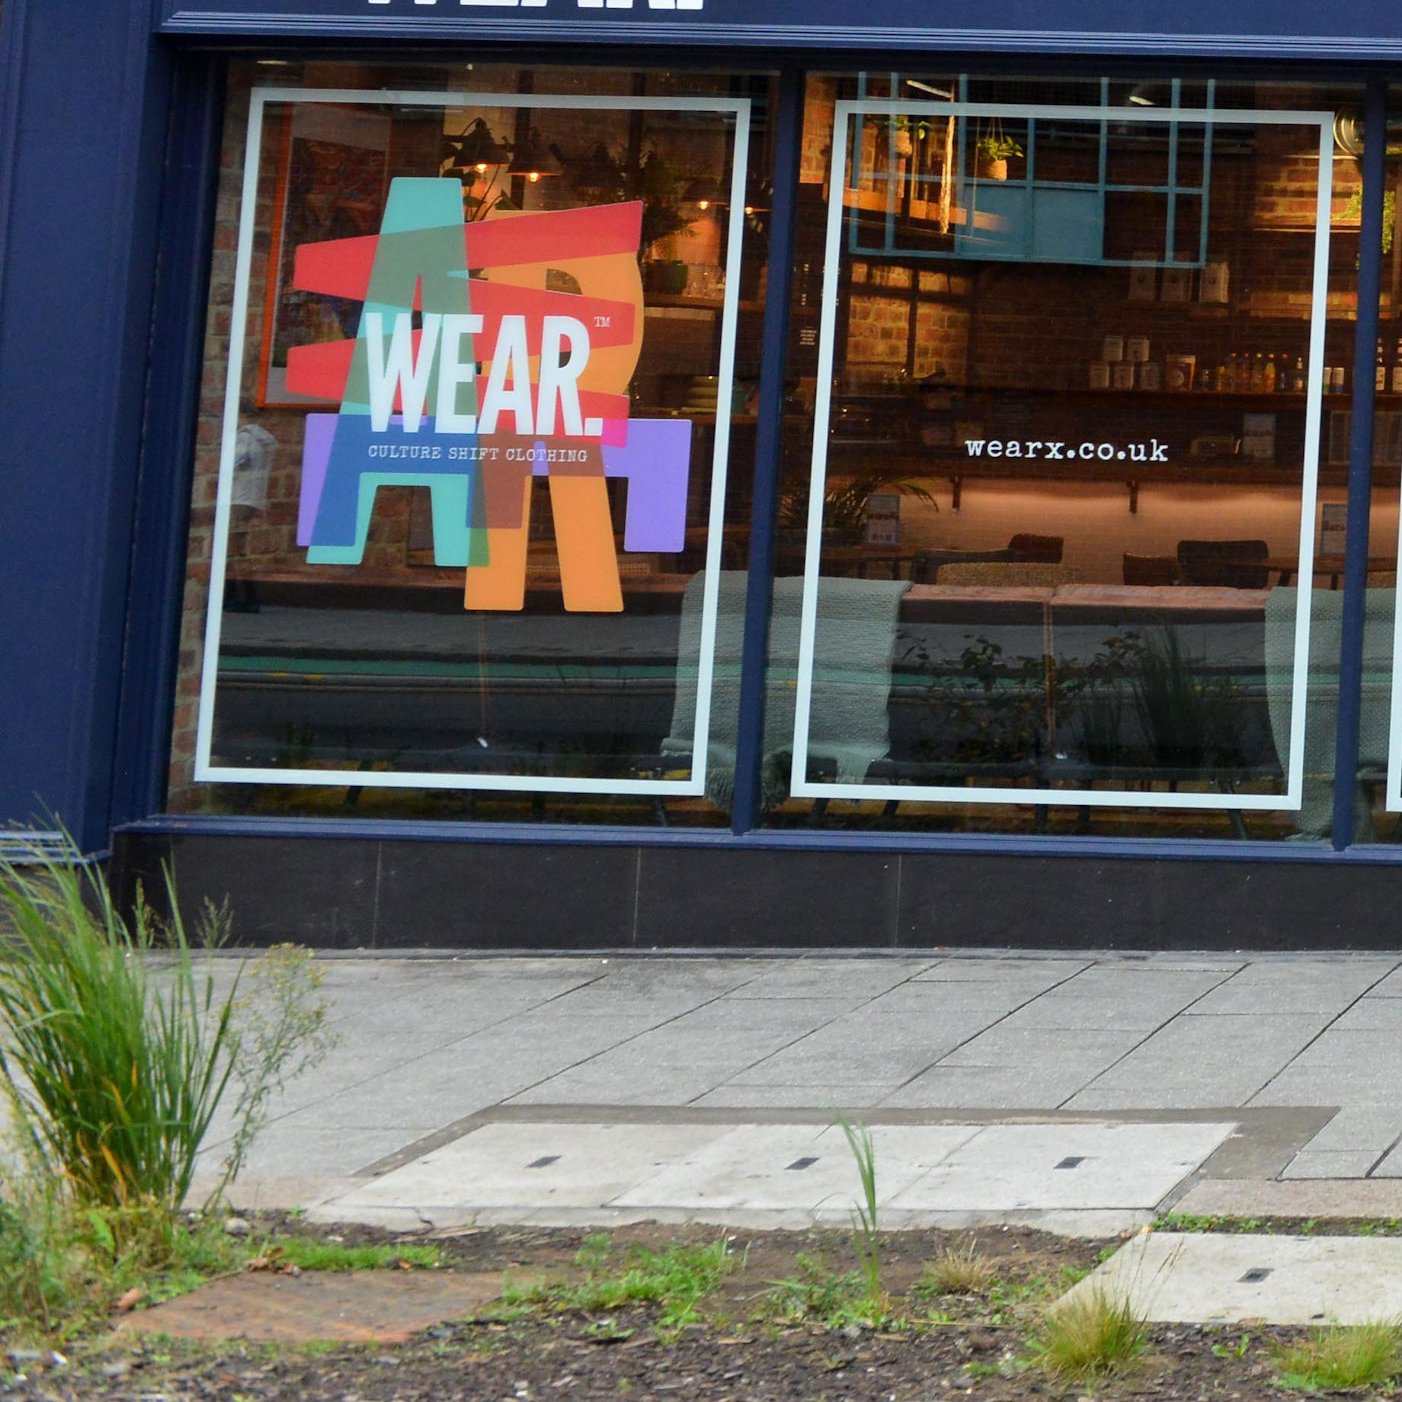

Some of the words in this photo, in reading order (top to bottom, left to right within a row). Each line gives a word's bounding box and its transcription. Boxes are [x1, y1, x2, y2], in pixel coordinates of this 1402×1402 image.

[366, 313, 603, 437] WEAR.
[368, 444, 442, 460] CULTURE
[448, 447, 500, 461] SHIFT
[506, 448, 588, 463] CLOTHING
[964, 435, 1169, 464] wearx.co.uk
